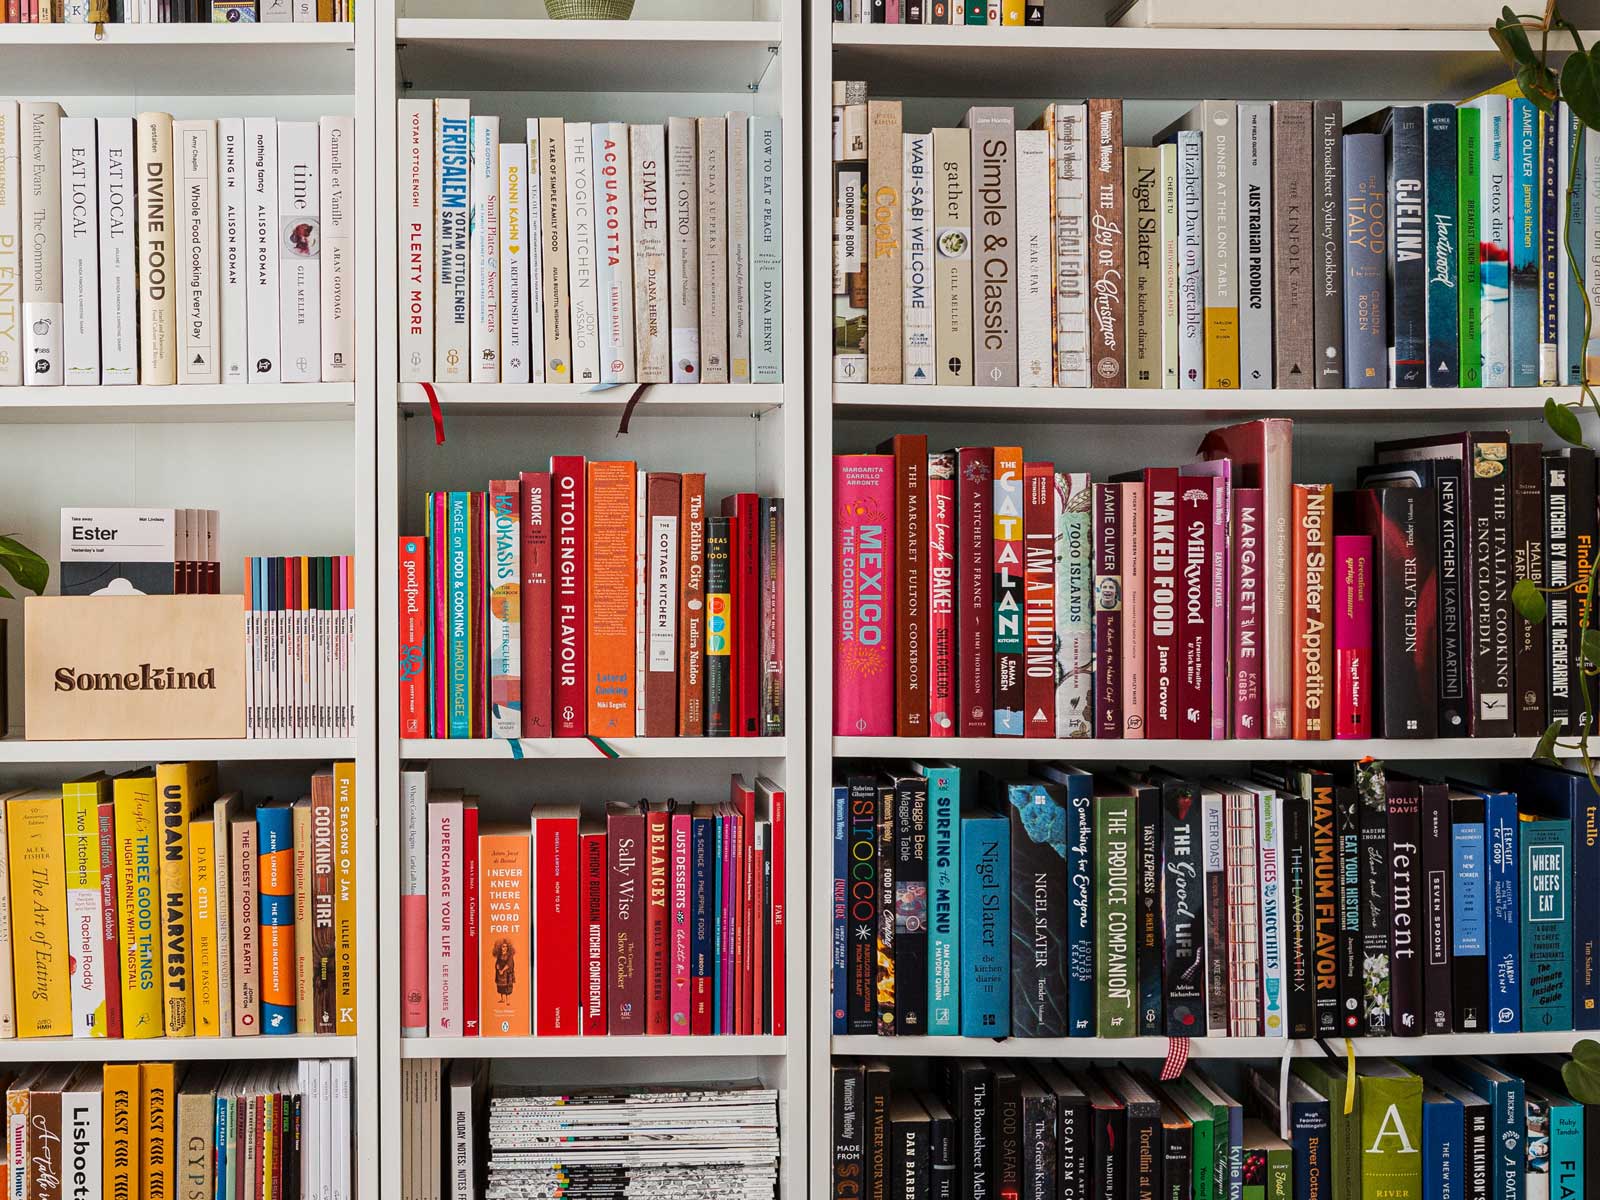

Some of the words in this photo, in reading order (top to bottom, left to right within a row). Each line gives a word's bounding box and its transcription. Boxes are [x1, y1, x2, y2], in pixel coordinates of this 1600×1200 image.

[33, 114, 45, 161] Matthew
[150, 124, 158, 152] gestalten
[1324, 114, 1335, 135] The
[1522, 106, 1532, 136] JAMIE
[33, 164, 45, 196] Evans
[72, 148, 85, 178] EAT
[412, 148, 420, 207] OTTOLENGHI
[442, 117, 466, 208] JERUSALEM
[1184, 143, 1199, 205] Elizabeth
[1324, 138, 1335, 197] Broadsheet
[1523, 140, 1532, 176] OLIVER
[147, 162, 164, 232] DIVINE
[192, 185, 201, 216] Whole
[294, 163, 312, 209] time
[509, 167, 518, 203] RONNI
[643, 160, 657, 230] SIMPLE
[911, 140, 924, 221] WABI-SABI
[944, 162, 962, 220] gather
[978, 140, 1007, 225] Simple
[1132, 167, 1155, 214] Nigel
[1491, 175, 1503, 213] Detox
[34, 209, 45, 230] The
[73, 183, 86, 238] LOCAL
[509, 208, 519, 240] KAHN
[603, 140, 620, 266] ACQUACOTTA
[678, 190, 689, 235] OSTRO
[845, 187, 854, 231] COOKBOOK
[875, 186, 898, 258] Cook
[1322, 201, 1335, 239] Sydney
[1396, 179, 1421, 262] GJELINA
[192, 219, 201, 243] Food
[442, 212, 452, 239] SAMI
[455, 212, 465, 249] YOTAM
[846, 235, 855, 257] BOOK
[984, 235, 1007, 251] &
[1138, 218, 1155, 269] Slater
[1185, 209, 1199, 246] David
[1492, 218, 1503, 243] diet
[34, 233, 45, 292] Commons
[148, 240, 165, 300] FOOD
[191, 246, 202, 287] Cooking
[411, 223, 421, 286] PLENTY
[912, 227, 924, 308] WELCOME
[1186, 250, 1195, 267] on
[1325, 242, 1336, 296] Cookbook
[1431, 214, 1454, 287] Hartwood
[191, 290, 202, 317] Every
[455, 254, 465, 323] OTTOLENGHI
[984, 258, 1008, 350] Classic
[1182, 271, 1199, 338] Vegetables
[192, 321, 202, 339] Day
[411, 291, 422, 335] MORE
[909, 465, 917, 488] THE
[1000, 461, 1017, 469] THE
[454, 501, 464, 533] McGEE
[531, 488, 541, 525] SMOKE
[690, 495, 701, 519] The
[1303, 494, 1324, 546] Nigel
[1443, 482, 1453, 515] NEW
[1494, 485, 1505, 519] THE
[72, 526, 118, 541] Ester
[455, 537, 462, 547] on
[560, 476, 574, 594] OTTOLENGHI
[690, 521, 701, 561] Edible
[843, 527, 853, 554] THE
[909, 496, 917, 561] MARGARET
[1153, 491, 1174, 571] NAKED
[1443, 520, 1455, 578] KITCHEN
[455, 551, 464, 578] FOOD
[659, 534, 668, 579] COTTAGE
[998, 471, 1019, 636] CATALAN
[1184, 521, 1204, 624] Milkwood
[1495, 527, 1506, 600] ITALIAN
[688, 565, 701, 590] City
[843, 558, 853, 641] COOKBOOK
[859, 526, 882, 645] MEXICO
[909, 570, 917, 615] FULTON
[1306, 552, 1325, 612] Slater
[1406, 558, 1417, 605] SLATER
[1478, 518, 1490, 656] ENCYCLOPEDIA
[455, 591, 464, 637] COOKING
[659, 584, 668, 627] KITCHEN
[1153, 576, 1173, 635] FOOD
[1445, 588, 1456, 632] KAREN
[561, 605, 575, 686] FLAVOUR
[1406, 606, 1416, 652] NIGEL
[1497, 609, 1507, 688] COOKING
[54, 663, 216, 692] Somekind
[455, 641, 465, 681] HAROLD
[1158, 646, 1169, 674] Jane
[1301, 618, 1324, 709] Appetite
[1446, 638, 1457, 693] MARTINI
[456, 684, 465, 716] McGEE
[1159, 676, 1169, 720] Grover
[77, 809, 86, 831] Two
[164, 785, 182, 860] URBAN
[315, 806, 330, 873] COOKING
[676, 829, 685, 854] JUST
[937, 797, 950, 868] SURFING
[1108, 810, 1127, 834] THE
[1586, 806, 1598, 846] trullo
[78, 836, 88, 885] Kitchens
[137, 836, 149, 883] THREE
[197, 847, 207, 880] DARK
[441, 818, 450, 897] SUPERCHARGE
[613, 838, 634, 874] Sally
[853, 800, 874, 921] sirocco
[1314, 787, 1334, 898] MAXIMUM
[1532, 855, 1560, 871] WHERE
[32, 869, 48, 896] The
[652, 824, 664, 907] DELANCEY
[676, 857, 685, 908] DESSERTS
[938, 871, 949, 887] the
[1108, 842, 1127, 904] PRODUCE
[1533, 875, 1560, 891] CHEFS
[33, 901, 49, 928] Art
[138, 888, 151, 929] GOOD
[199, 888, 209, 919] emu
[316, 895, 331, 927] FIRE
[441, 902, 450, 931] YOUR
[618, 880, 634, 920] Wise
[937, 889, 950, 934] MENU
[1393, 842, 1416, 959] ferment
[1433, 878, 1441, 911] SEVEN
[1539, 895, 1555, 911] EAT
[30, 931, 51, 946] of
[167, 893, 185, 991] HARVEST
[442, 935, 450, 957] LIFE
[1108, 912, 1130, 1008] COMPANION
[1316, 904, 1335, 990] FLAVOR
[31, 950, 51, 1001] Eating
[139, 934, 152, 990] THINGS
[844, 1079, 855, 1110] Women's
[974, 1083, 985, 1106] The
[457, 1111, 465, 1145] HOLIDAY
[842, 1112, 855, 1138] Weekly
[974, 1109, 985, 1167] Broadsheet
[1366, 1103, 1418, 1154] A
[1376, 1189, 1409, 1198] RIVER
